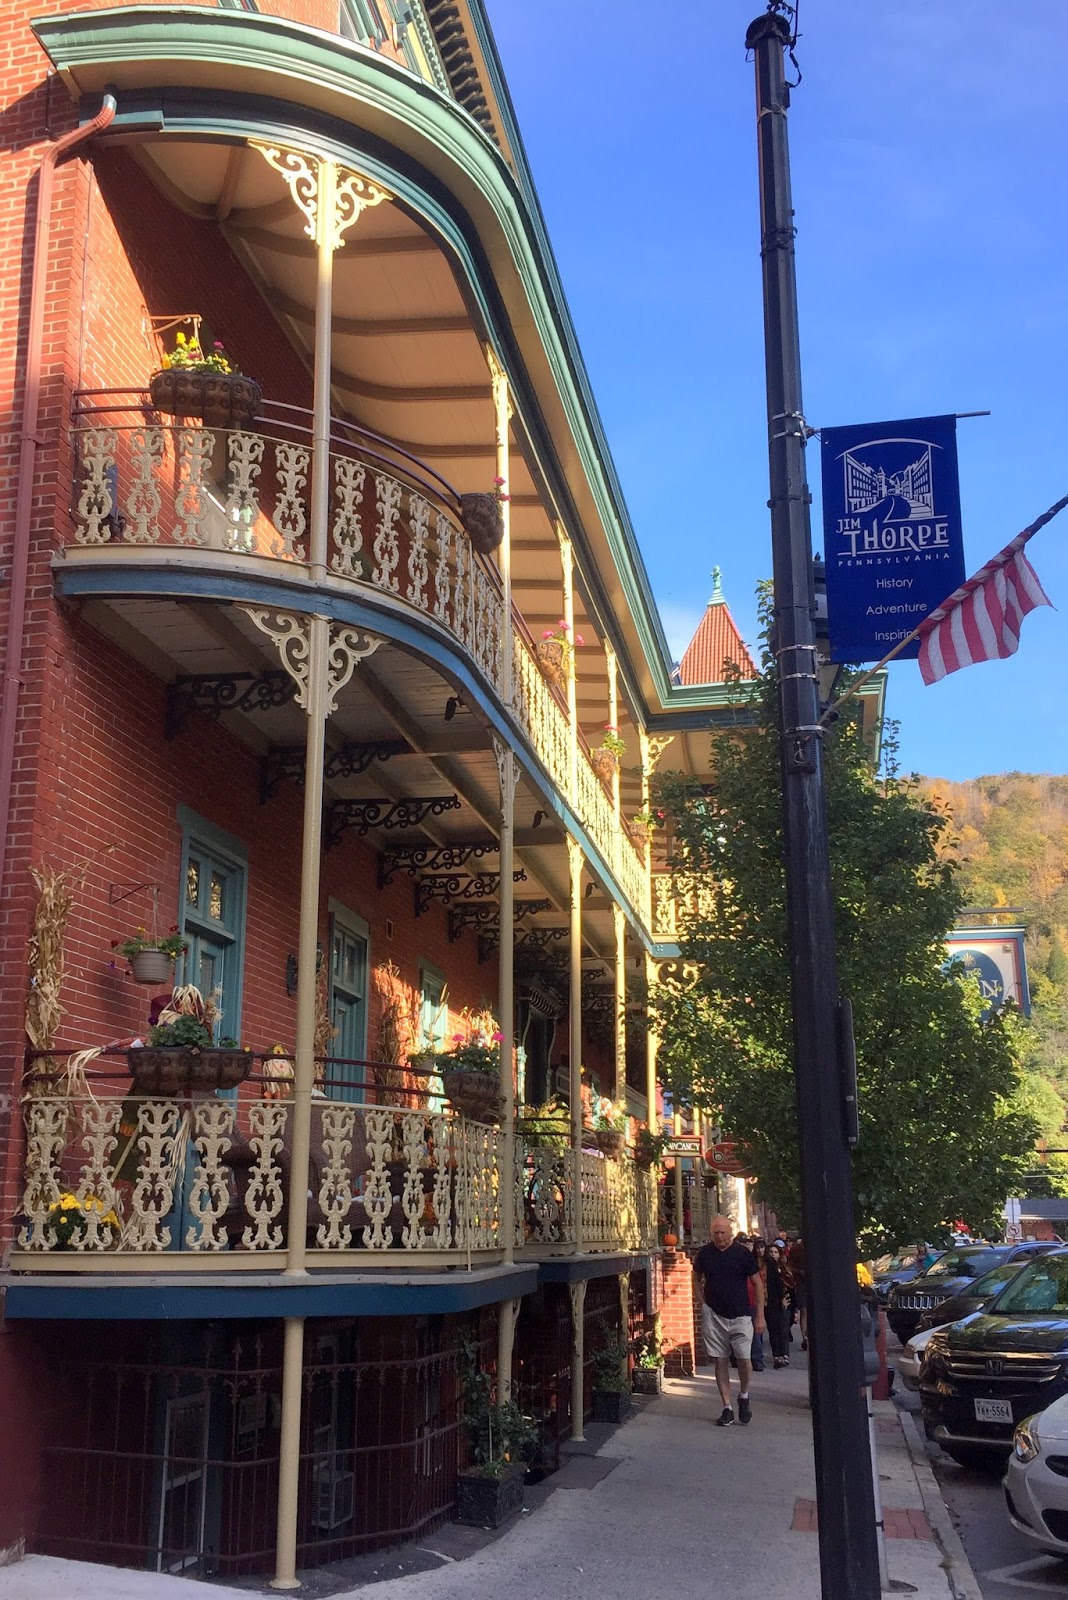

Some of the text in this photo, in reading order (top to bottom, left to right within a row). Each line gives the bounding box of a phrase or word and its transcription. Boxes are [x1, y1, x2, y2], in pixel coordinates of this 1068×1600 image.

[836, 517, 861, 534] JIM
[843, 518, 949, 557] THORPE
[838, 552, 950, 567] PENNSYLVANIA
[876, 578, 914, 590] History
[866, 602, 927, 615] Adventure
[667, 1142, 700, 1151] VACANCY
